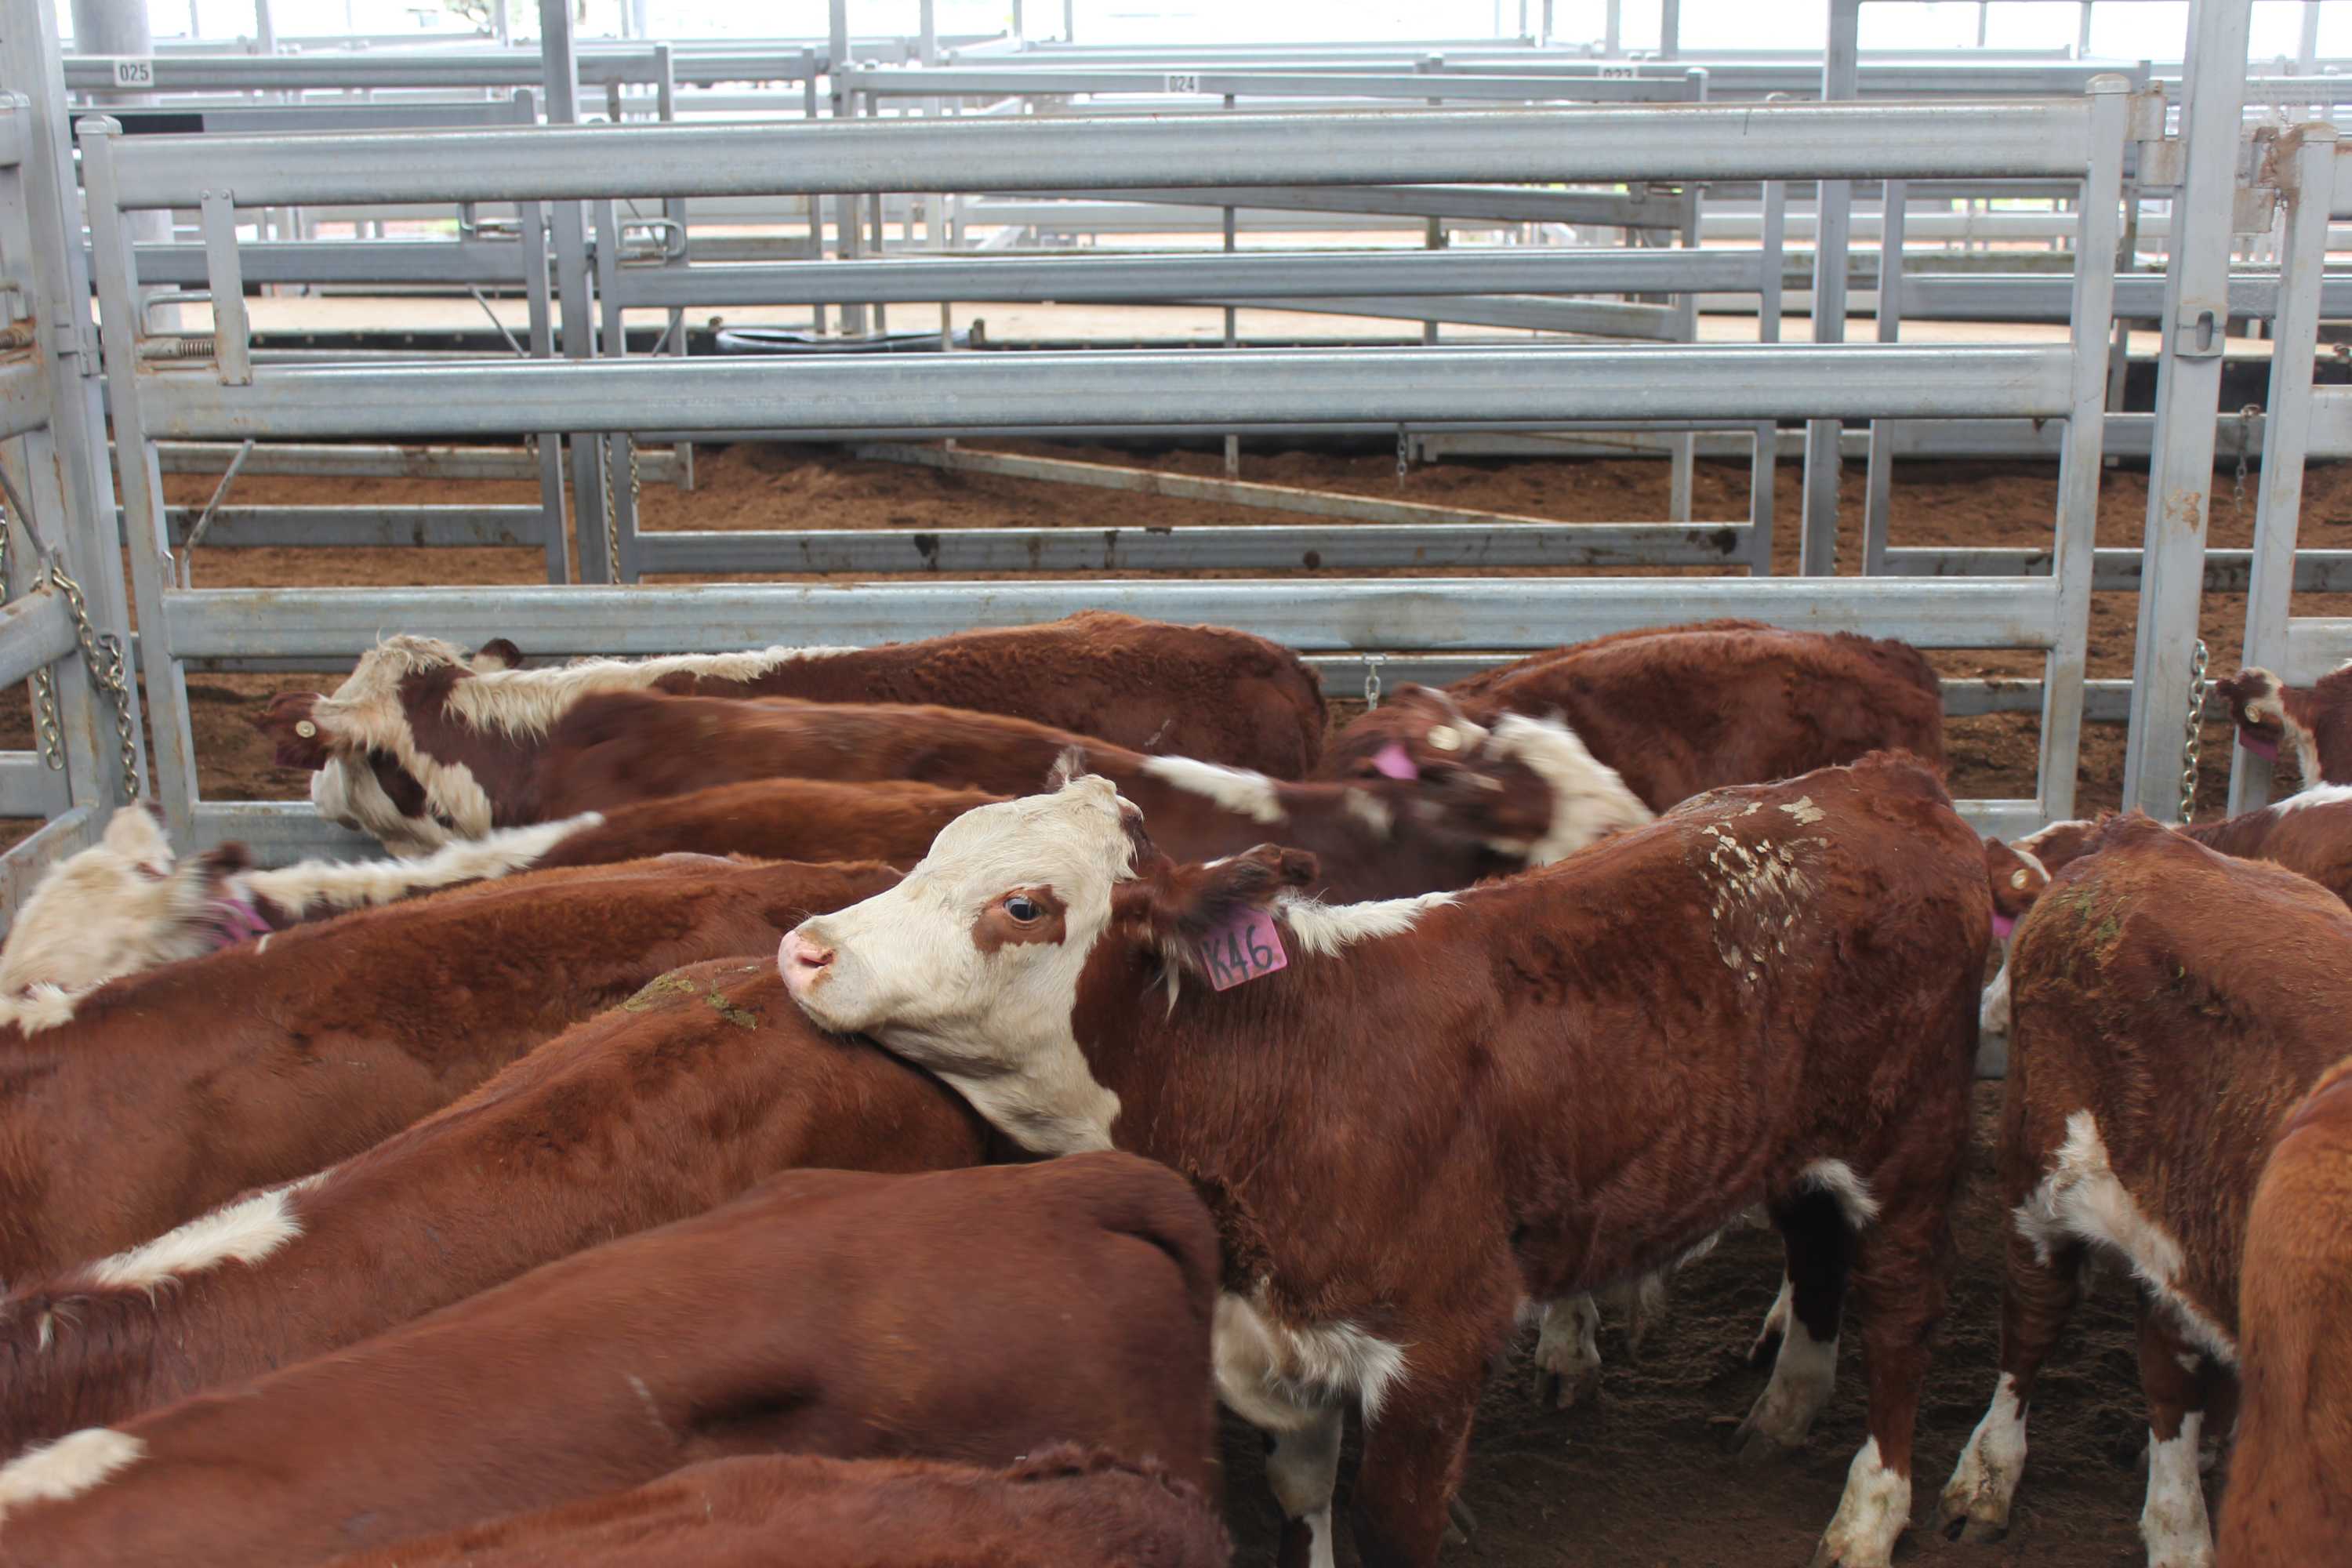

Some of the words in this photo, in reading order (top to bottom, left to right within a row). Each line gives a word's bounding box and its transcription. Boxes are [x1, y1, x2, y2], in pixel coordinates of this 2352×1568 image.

[120, 64, 149, 82] 025
[1169, 75, 1195, 93] 024
[1203, 924, 1273, 987] K46
